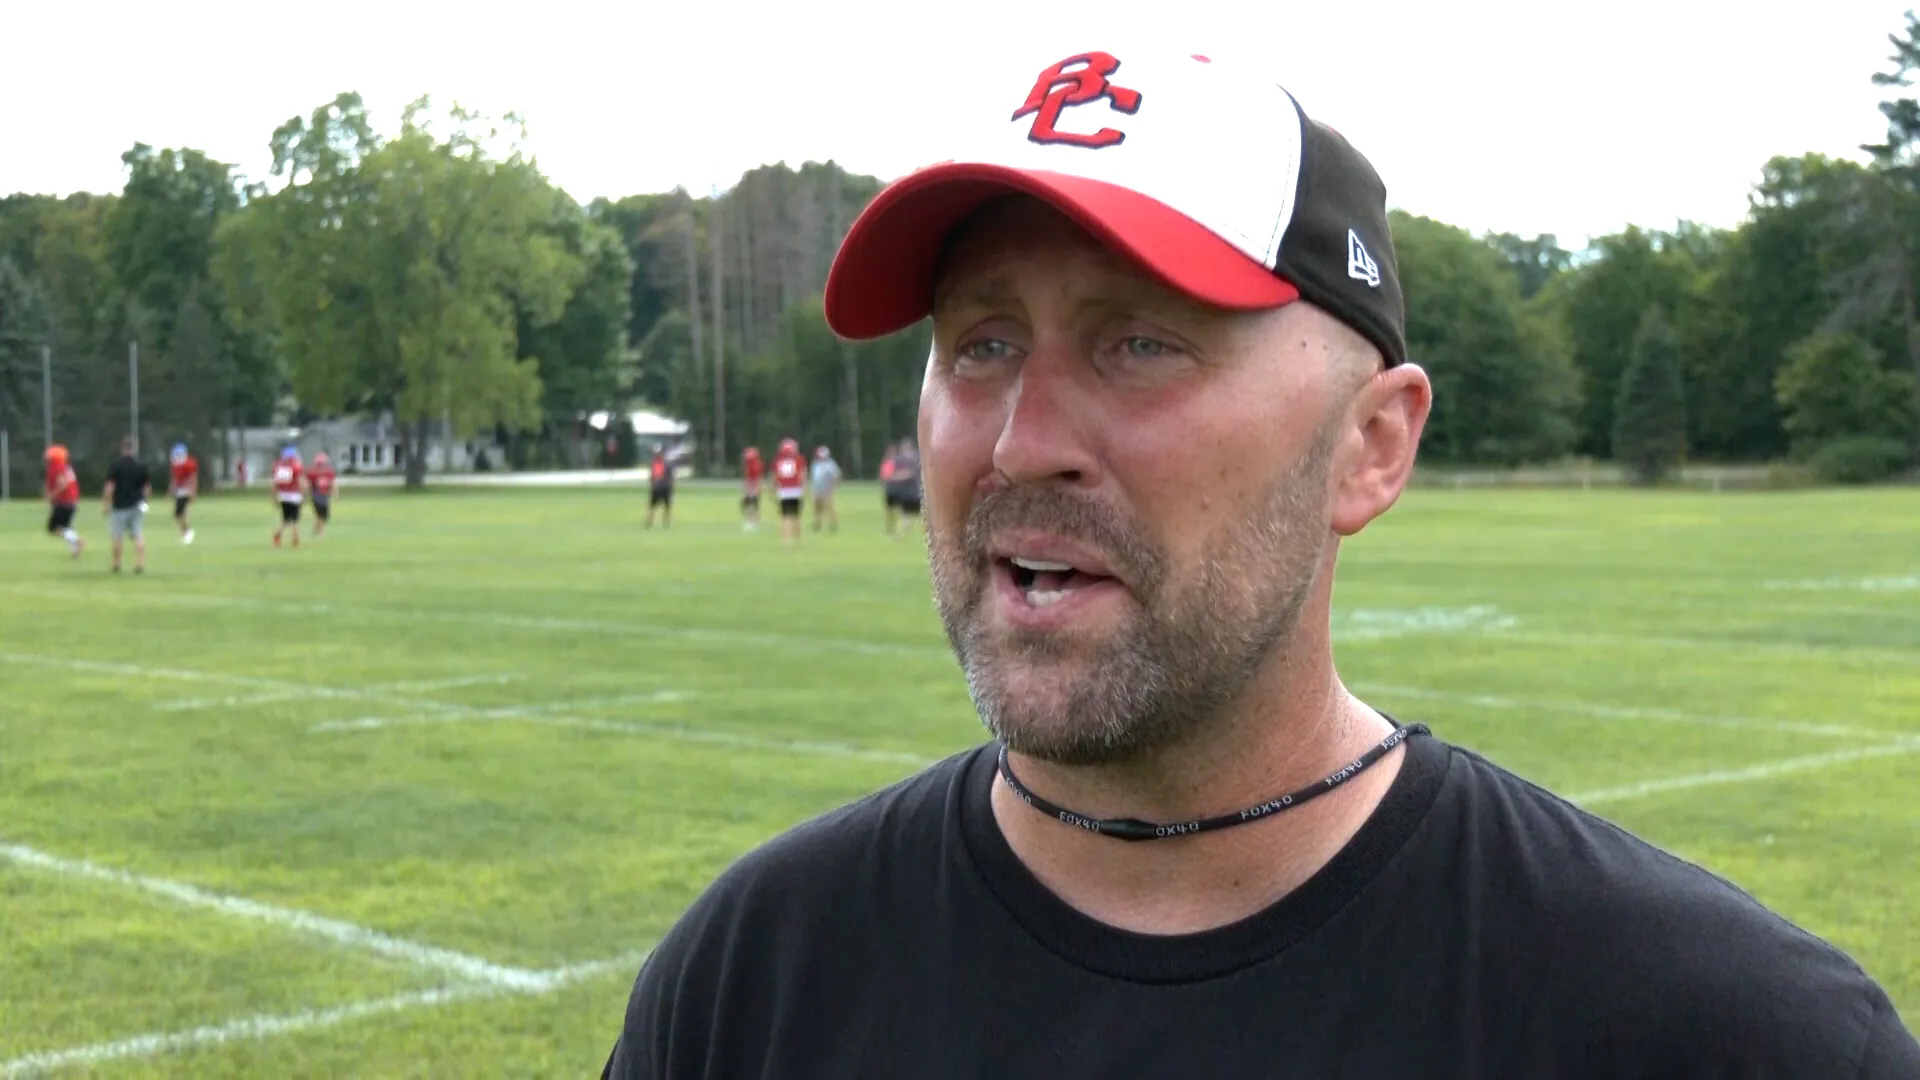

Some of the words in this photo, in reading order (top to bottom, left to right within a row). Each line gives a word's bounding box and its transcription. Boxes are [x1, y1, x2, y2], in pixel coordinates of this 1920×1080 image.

[1011, 51, 1142, 149] BC
[1241, 795, 1293, 820] FOX40
[1060, 811, 1100, 832] FOX40
[1155, 822, 1199, 837] OX40
